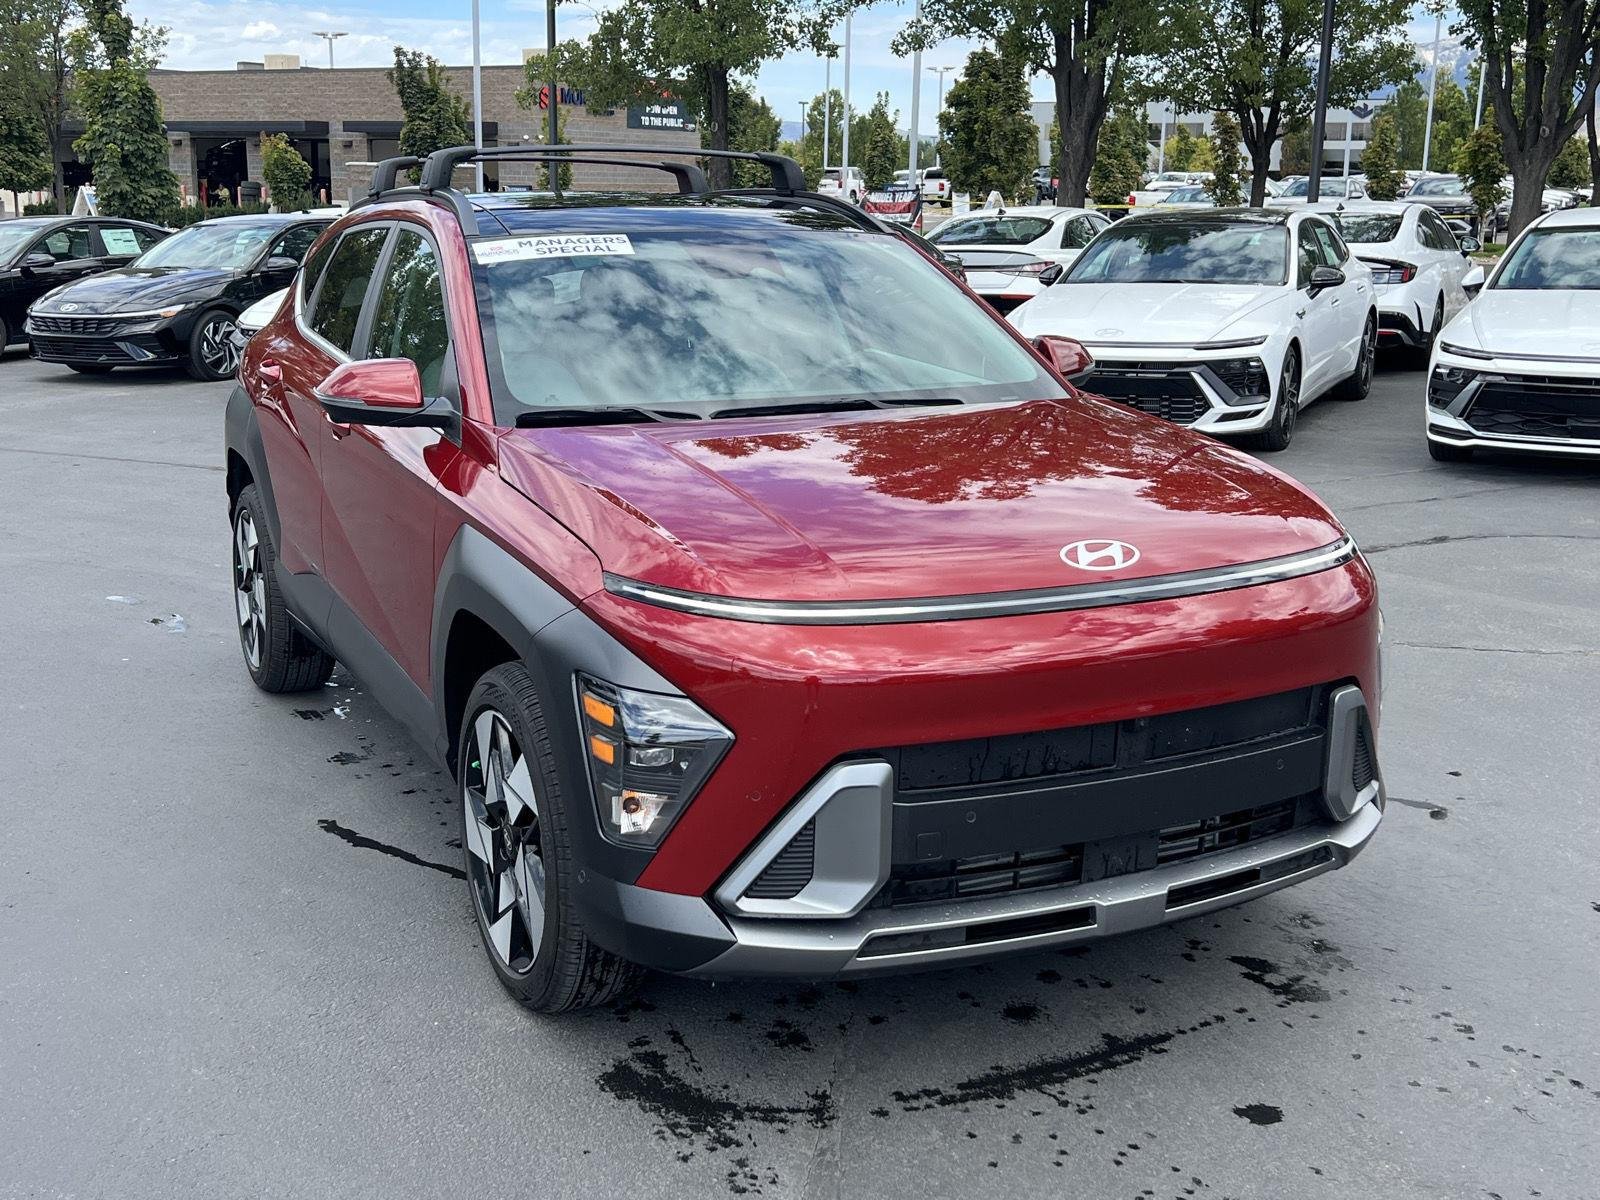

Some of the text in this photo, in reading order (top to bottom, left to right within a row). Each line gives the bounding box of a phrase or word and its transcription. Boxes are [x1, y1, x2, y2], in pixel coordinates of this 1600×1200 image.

[661, 105, 678, 115] OPEN
[641, 116, 650, 126] TO
[650, 117, 662, 126] THE
[663, 118, 684, 128] PUBLIC
[517, 236, 627, 248] MANAGERS
[535, 243, 618, 255] SPECIAL
